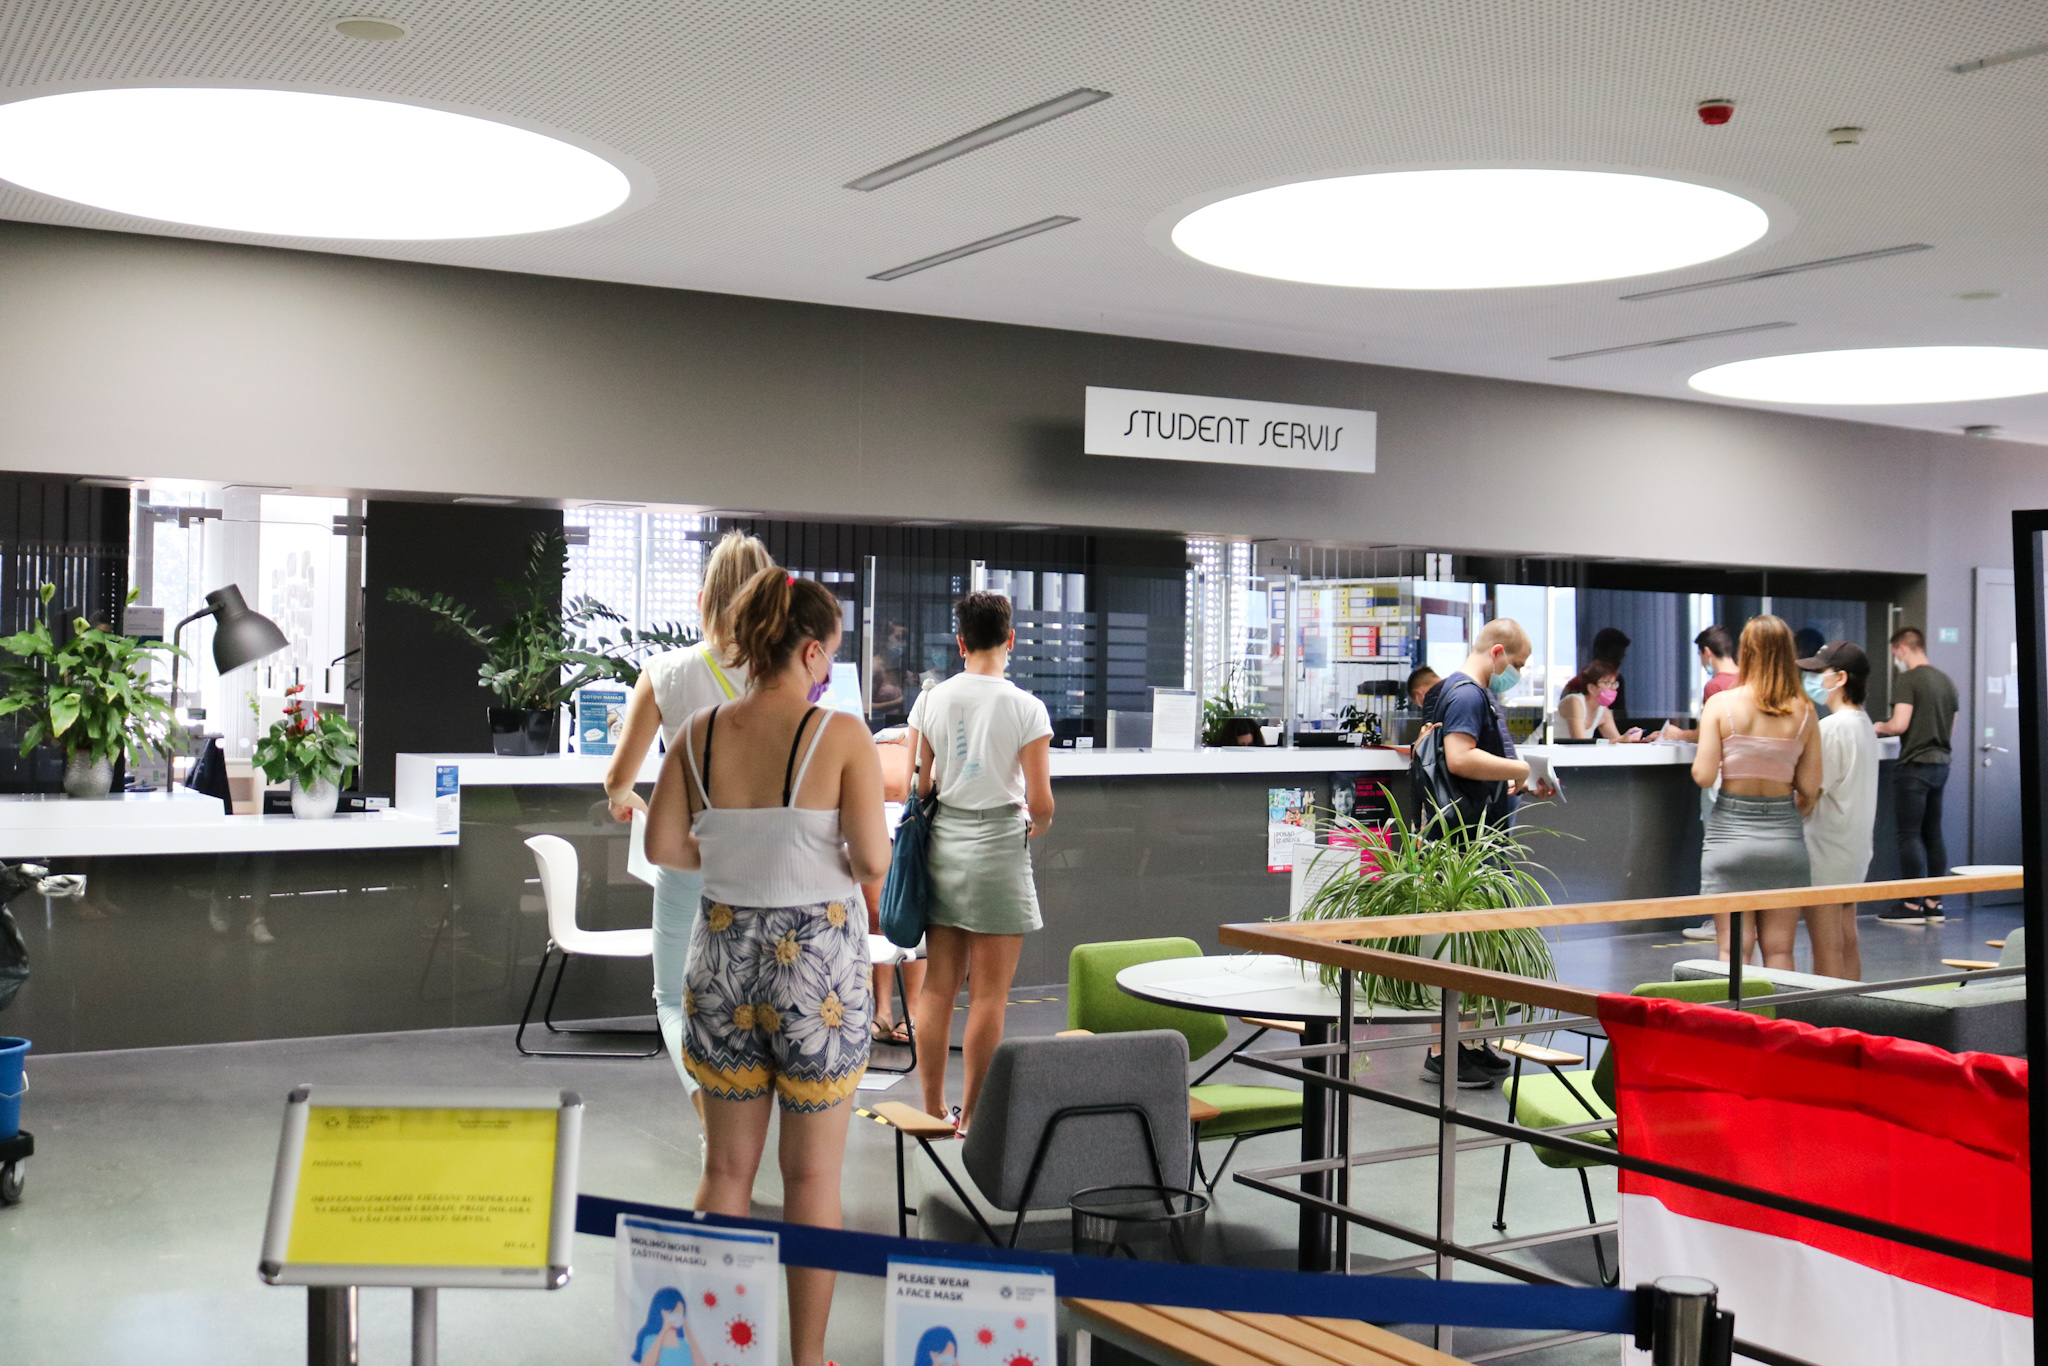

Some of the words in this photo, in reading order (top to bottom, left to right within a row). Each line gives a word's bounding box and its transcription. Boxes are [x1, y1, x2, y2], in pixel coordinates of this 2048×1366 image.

[1124, 410, 1250, 445] STUDENT
[1258, 421, 1344, 451] SERVIS
[630, 1236, 666, 1249] MOLIMO
[667, 1242, 700, 1253] NOSITE
[630, 1247, 673, 1262] ZAŠTITNU
[674, 1255, 707, 1267] MASKU
[897, 1272, 935, 1285] PLEASE
[937, 1276, 970, 1288] WEAR
[896, 1287, 903, 1296] A
[906, 1287, 931, 1298] FACE
[933, 1290, 963, 1301] MASK
